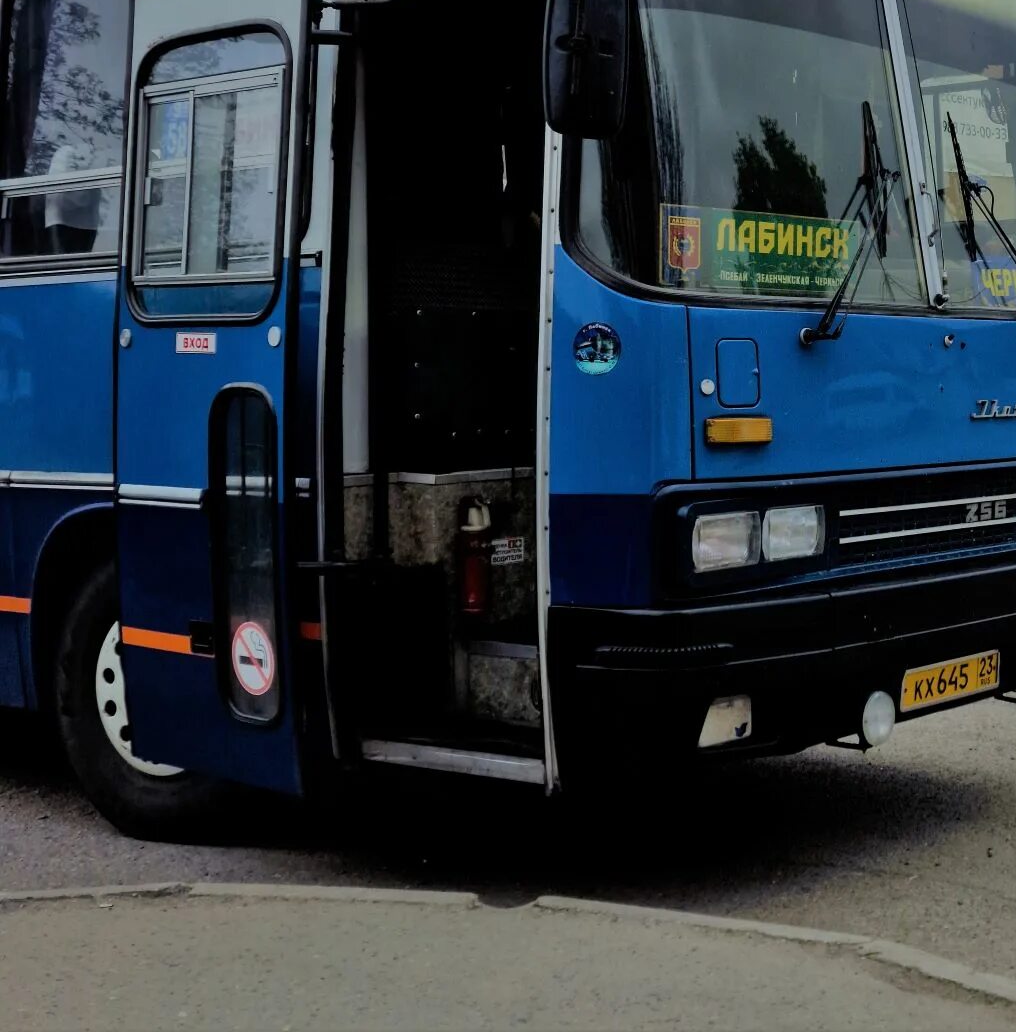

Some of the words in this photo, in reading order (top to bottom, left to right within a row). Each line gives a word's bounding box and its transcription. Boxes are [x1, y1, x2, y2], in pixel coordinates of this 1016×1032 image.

[960, 123, 1007, 139] 733-00-33
[717, 219, 849, 259] ЛАБИНСК
[720, 270, 748, 282] ПСЕБАЙ
[756, 273, 810, 286] ЗЕЛЕНЧУКСКАЯ
[815, 277, 845, 287] ЧЕРКЕСС
[183, 337, 209, 350] ВХОД
[966, 500, 1007, 523] 256
[979, 655, 994, 677] 23
